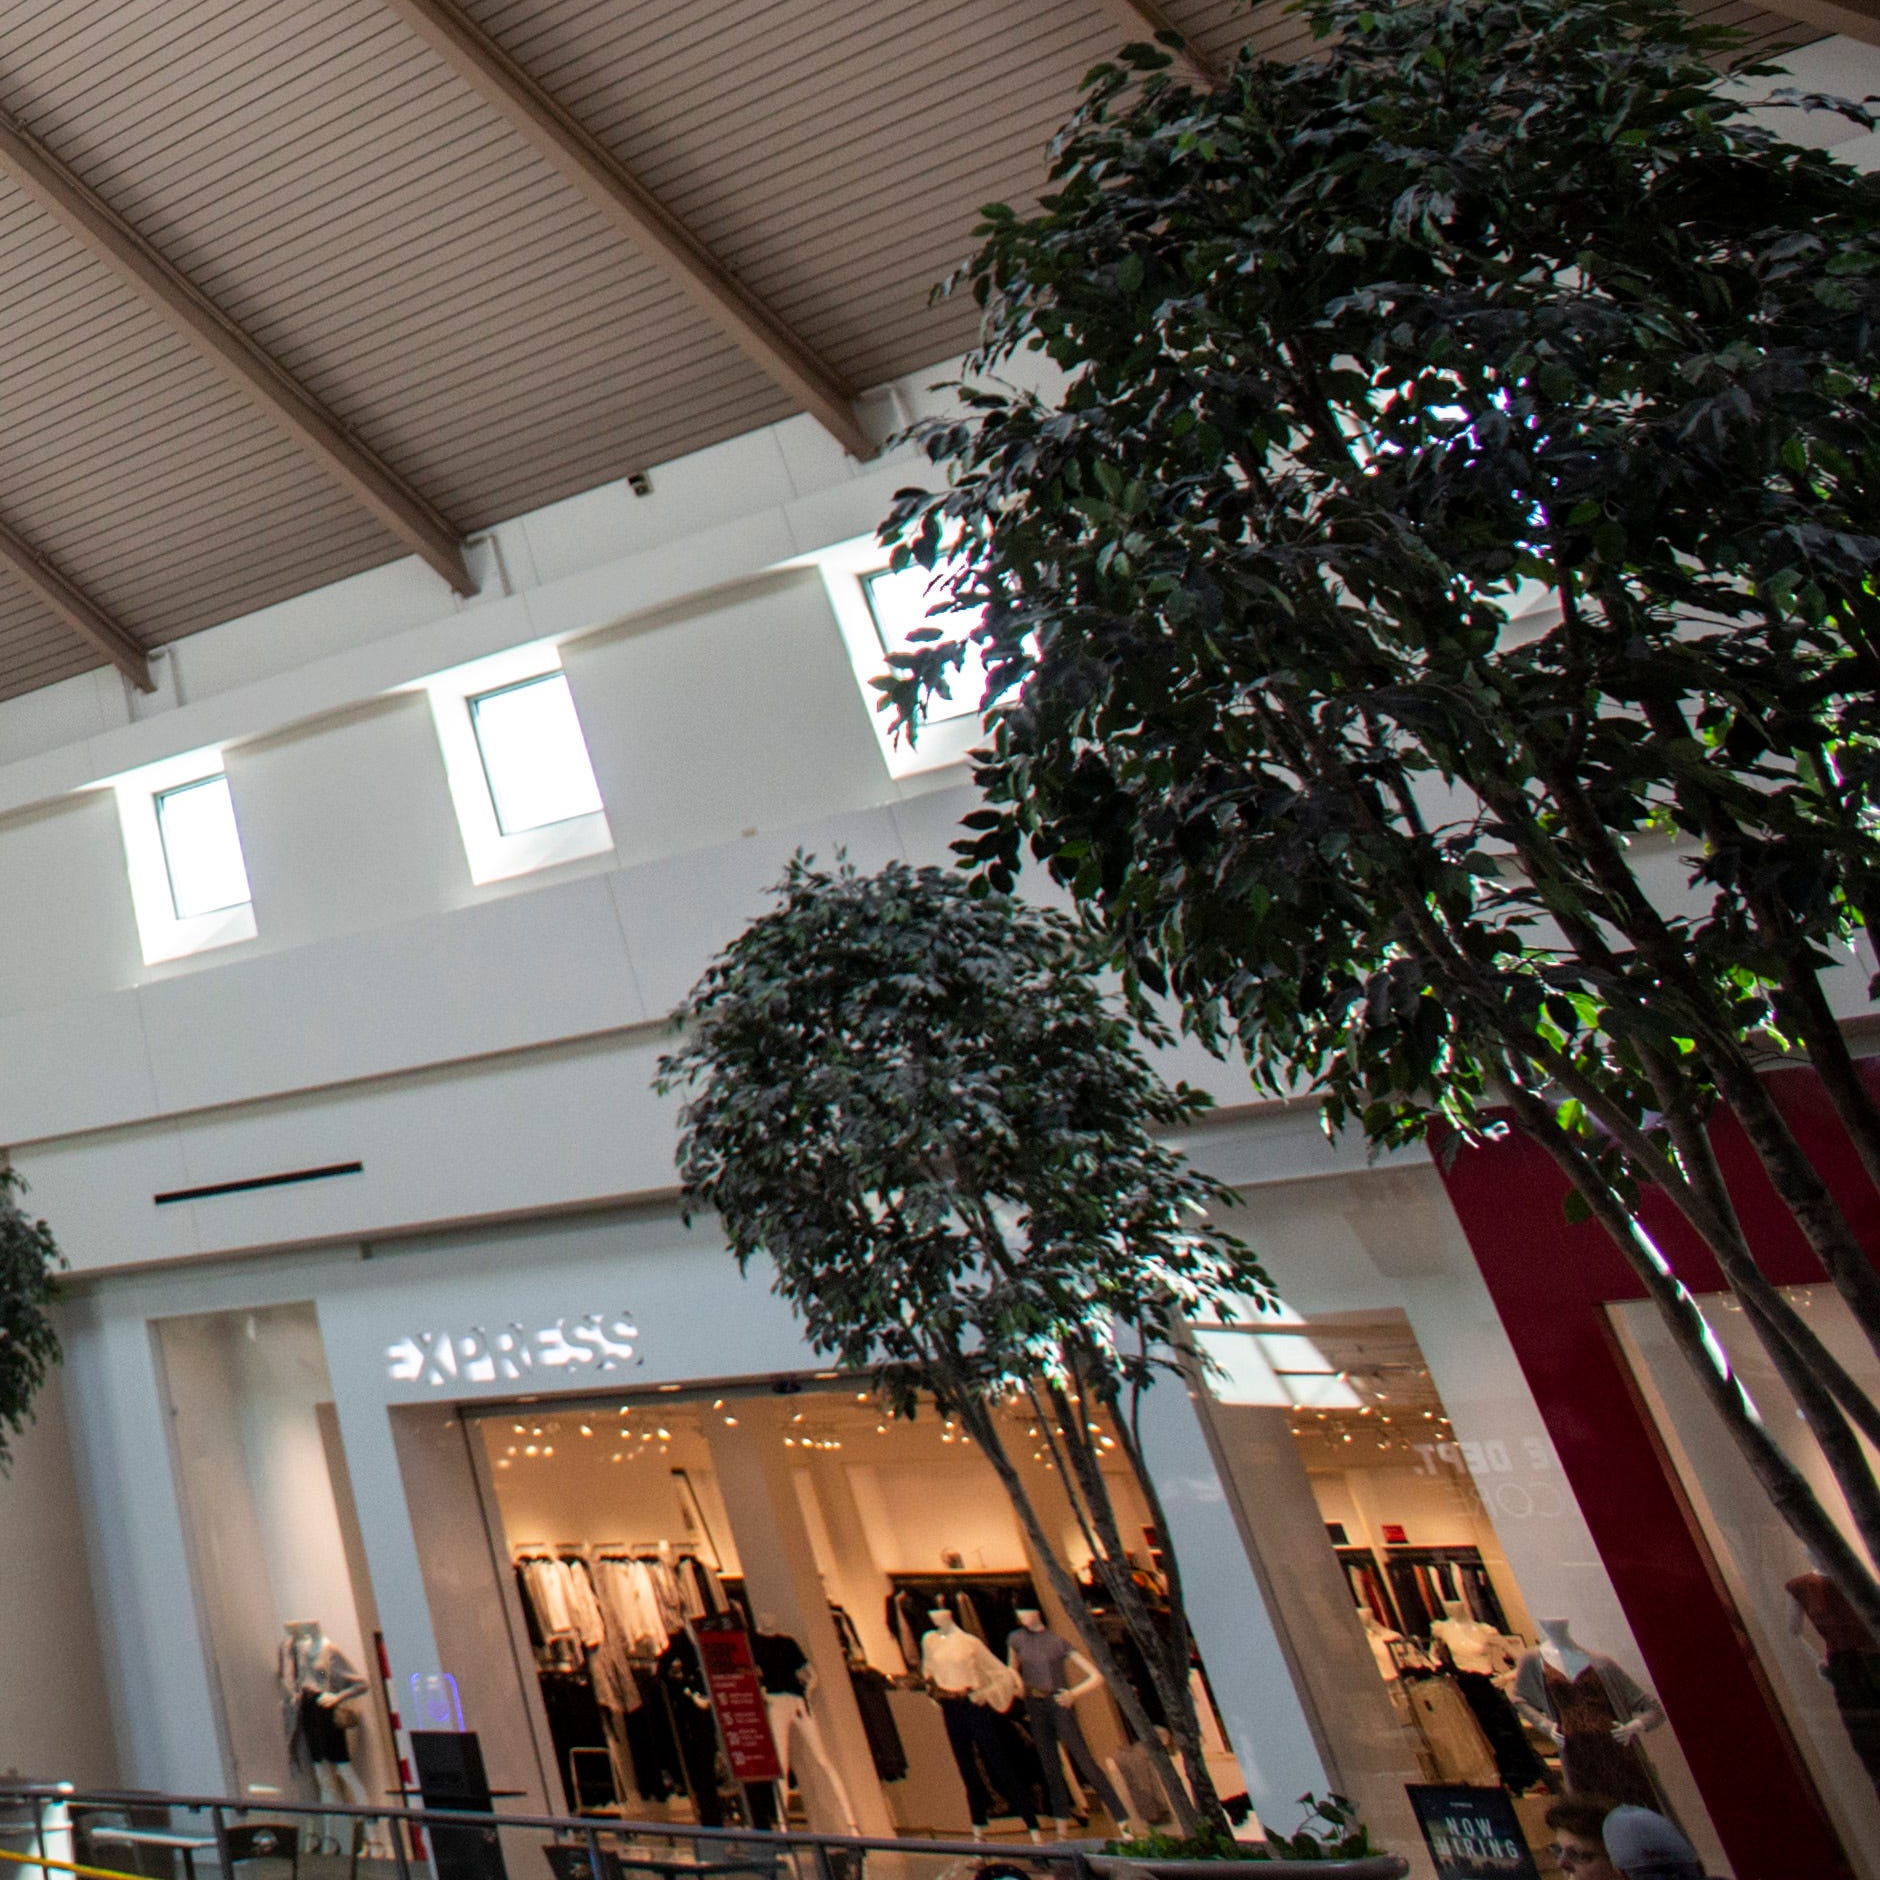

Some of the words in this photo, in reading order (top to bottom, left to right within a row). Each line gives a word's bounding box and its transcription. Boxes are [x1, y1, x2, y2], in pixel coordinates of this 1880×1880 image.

[385, 1311, 644, 1386] EXPRESS
[1445, 1817, 1493, 1837] NOW
[1438, 1836, 1520, 1859] HIRING
